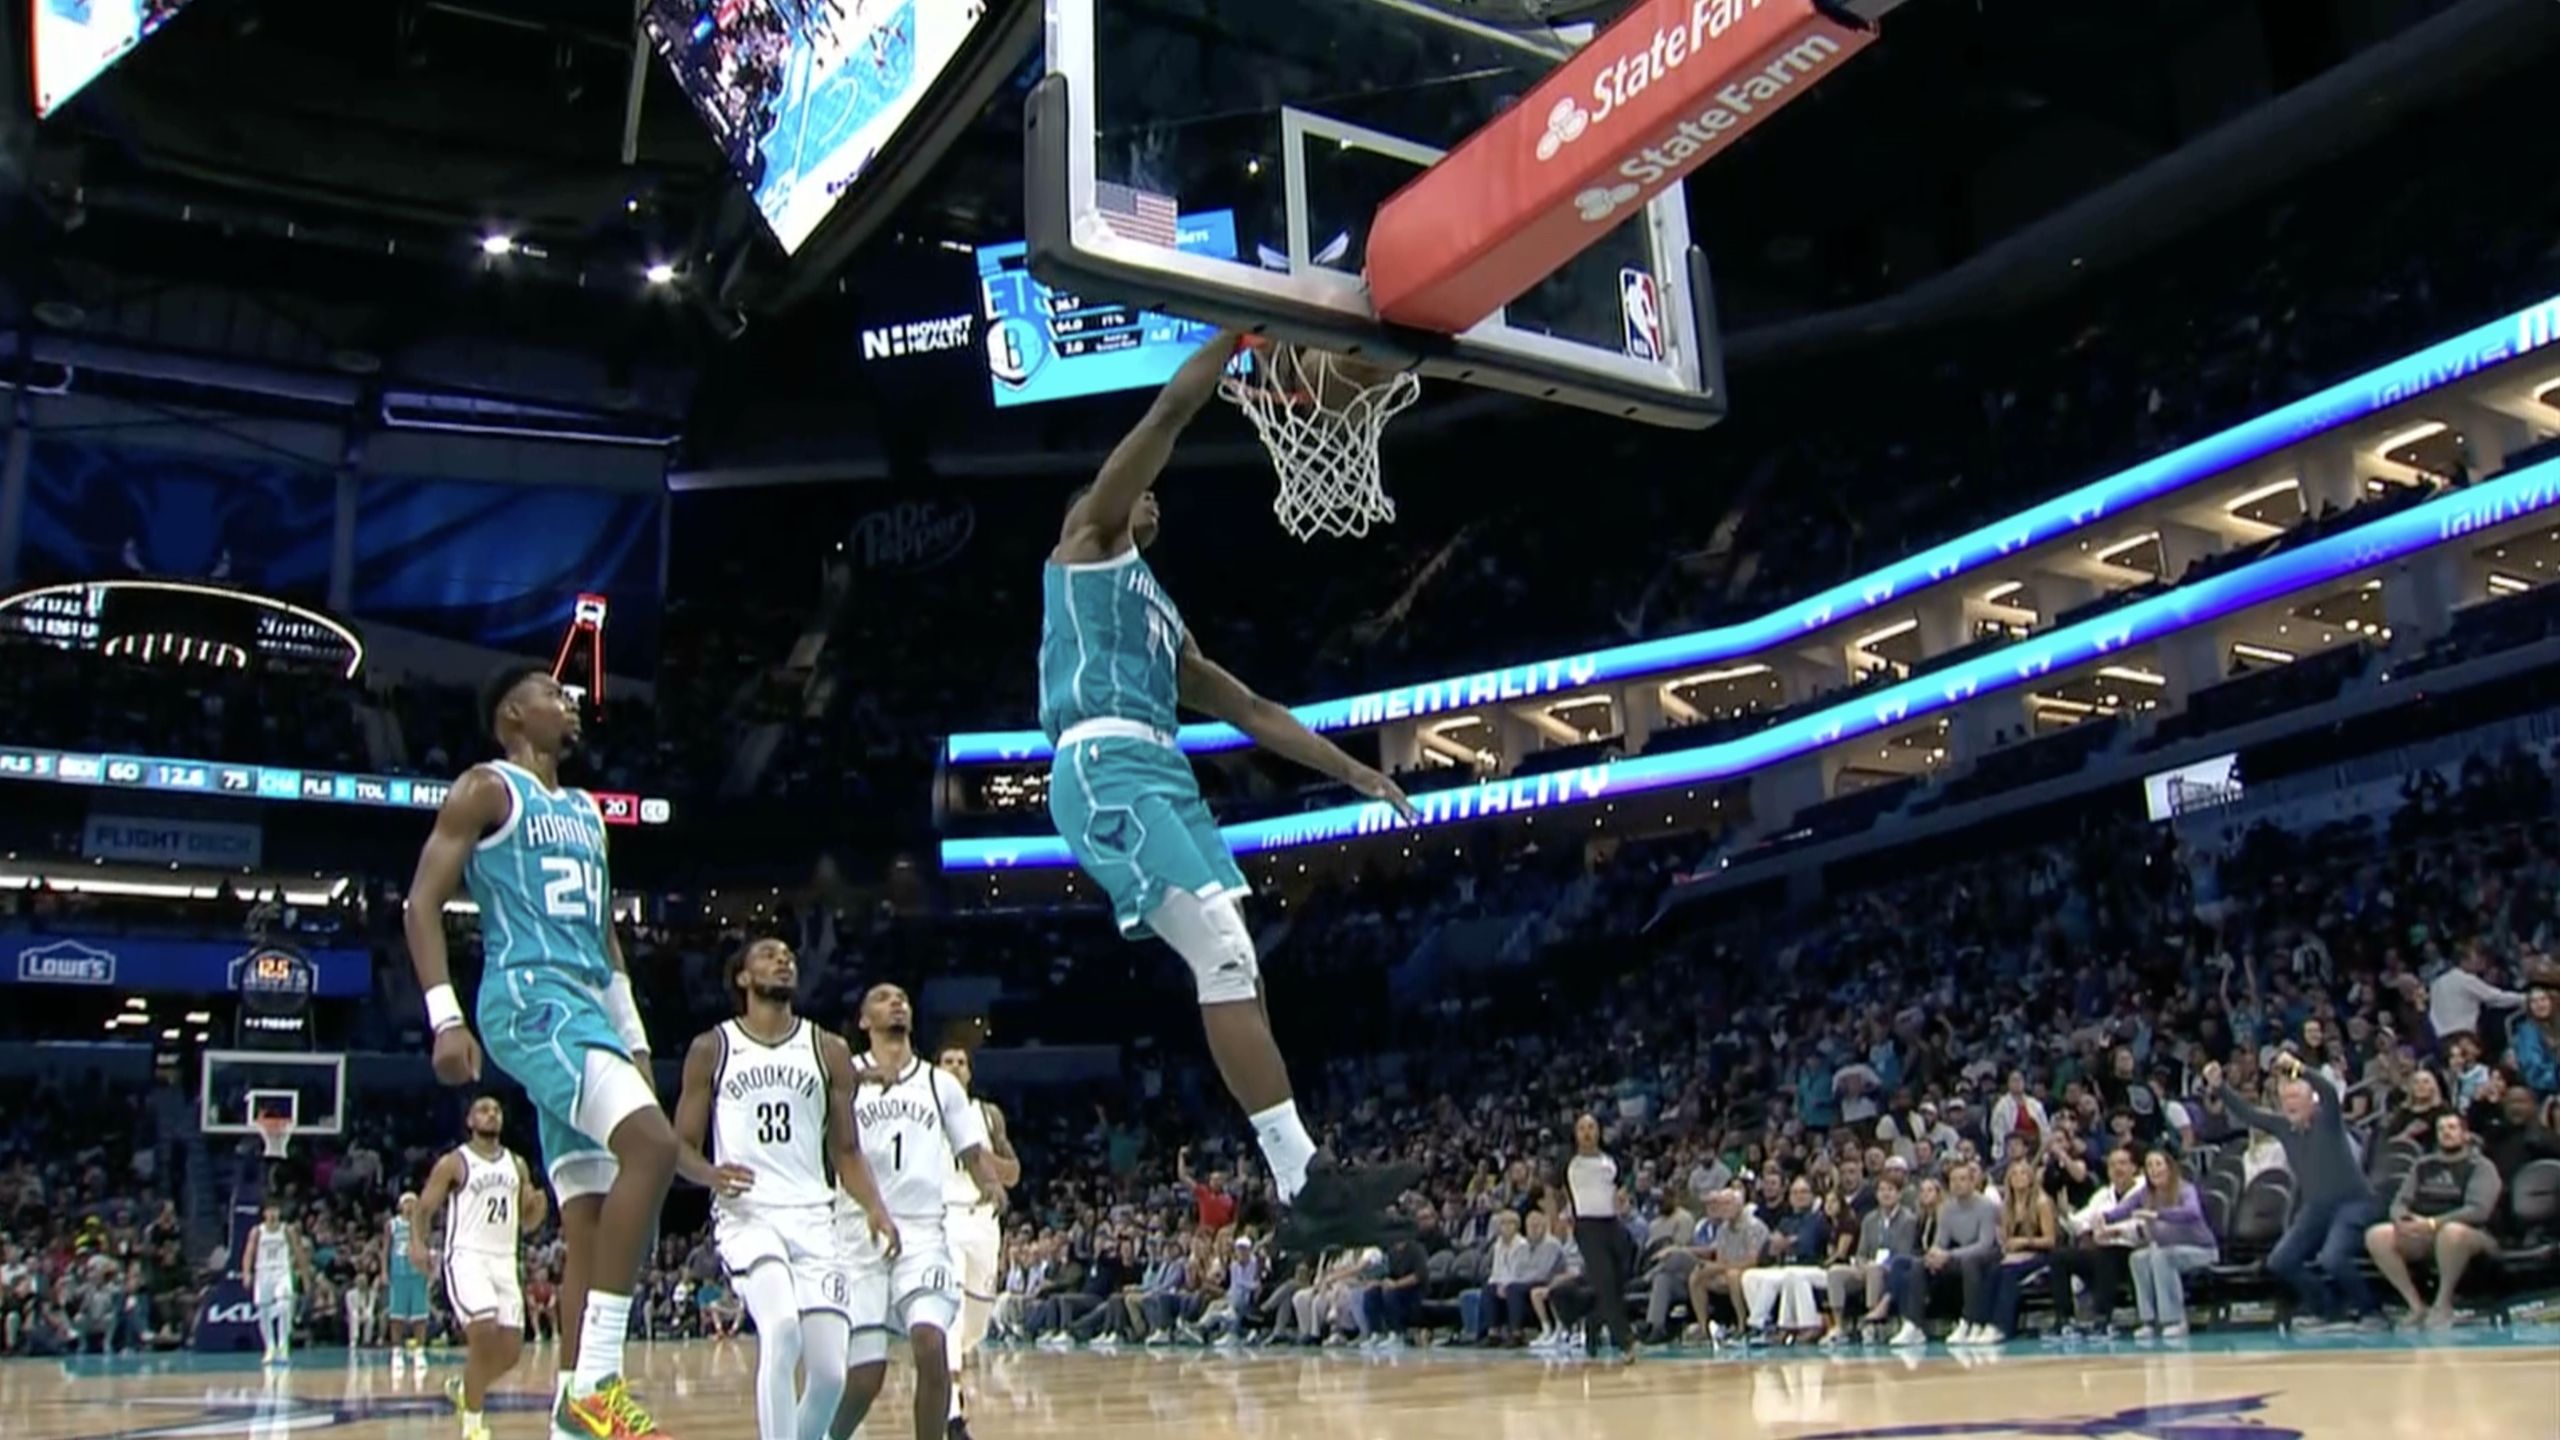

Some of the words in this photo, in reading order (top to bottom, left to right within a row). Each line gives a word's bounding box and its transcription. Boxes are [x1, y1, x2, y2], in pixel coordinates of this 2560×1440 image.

[1592, 24, 1687, 122] State
[1691, 0, 1761, 54] Far
[1620, 107, 1736, 183] State
[1715, 34, 1840, 114] Farm
[906, 314, 973, 339] NOVANT
[908, 331, 970, 354] HEALTH
[1350, 656, 1597, 727] MENTALITY
[108, 762, 140, 782] 60
[604, 798, 628, 818] 20
[95, 826, 183, 850] FLIGHT
[526, 813, 601, 848] HORN
[540, 855, 603, 926] 24
[29, 955, 107, 979] LOWE'S
[726, 1063, 820, 1100] BROOKLYN
[756, 1101, 792, 1144] 33
[856, 1099, 938, 1131] BROOKLYN
[890, 1130, 903, 1171] 1
[487, 1196, 508, 1225] 24
